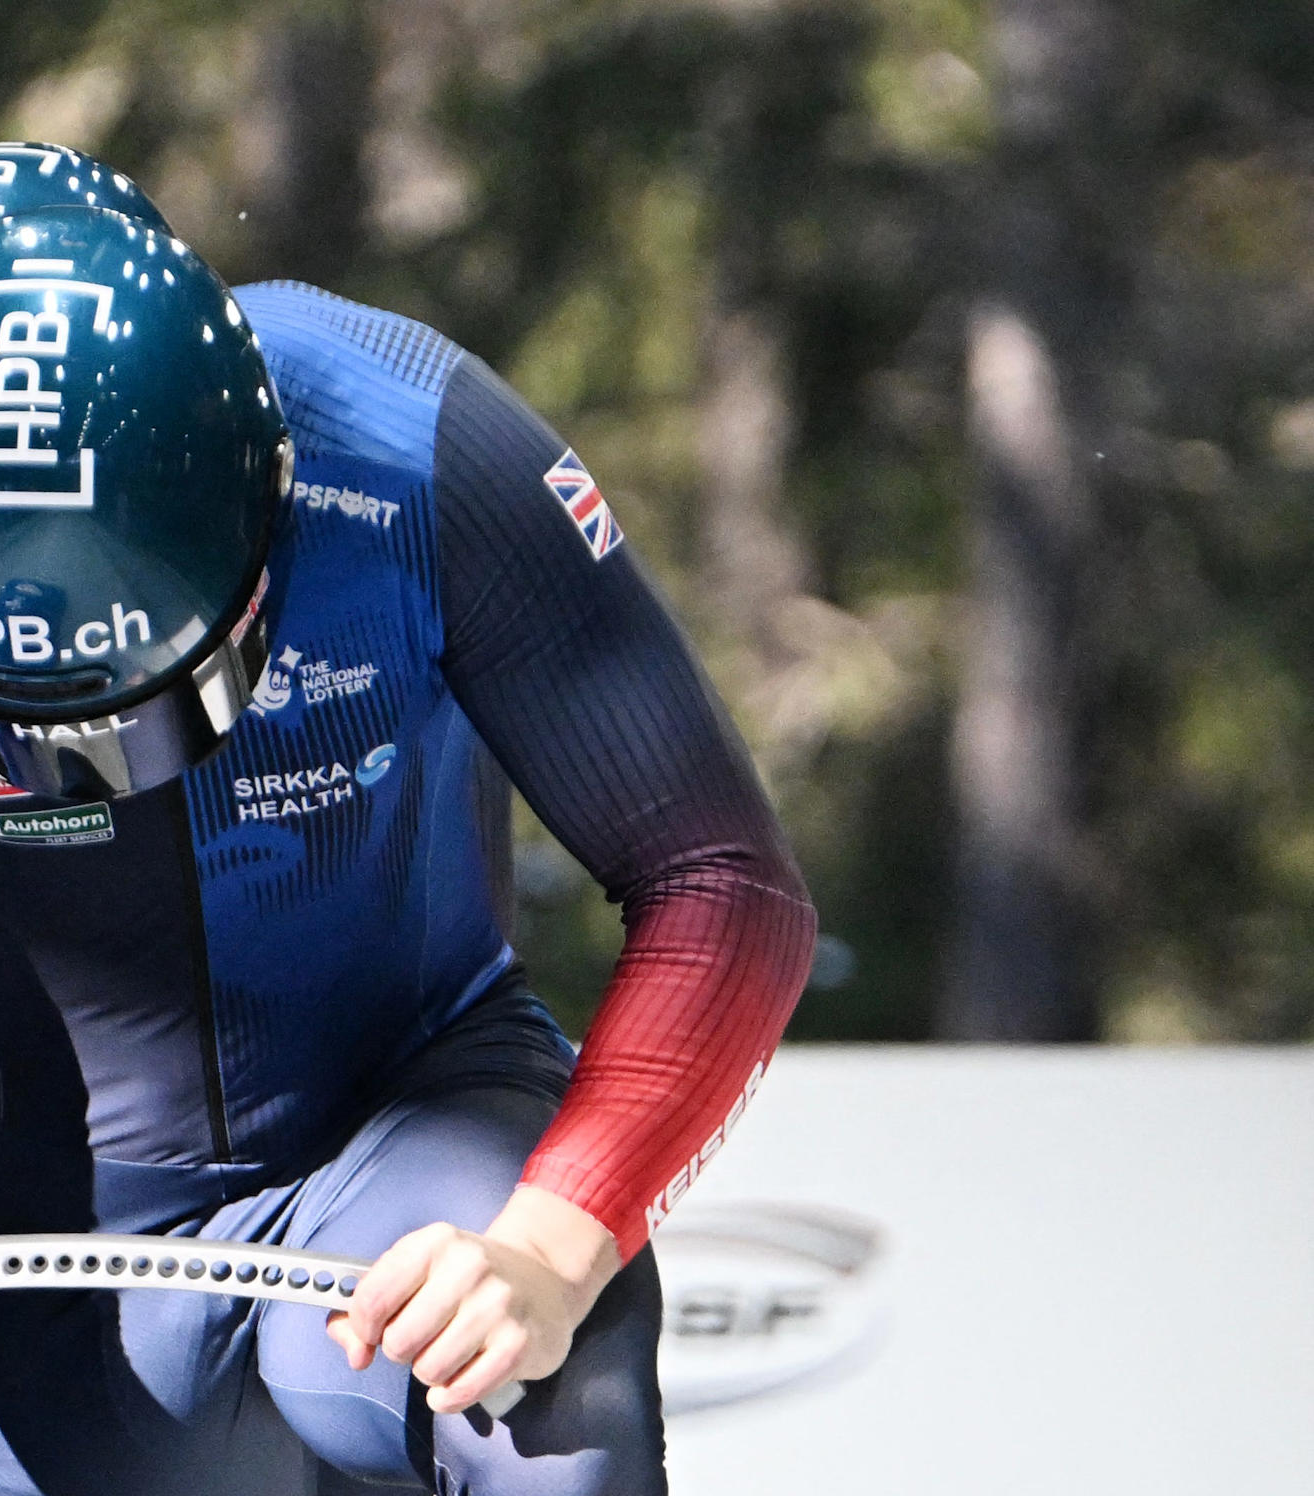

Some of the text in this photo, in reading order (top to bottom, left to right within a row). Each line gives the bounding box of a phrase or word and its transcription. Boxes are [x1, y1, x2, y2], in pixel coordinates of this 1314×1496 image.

[299, 659, 332, 678] THE
[301, 662, 380, 691] NATIONAL
[11, 714, 139, 739] HALL
[235, 762, 350, 798] SIRKKA
[238, 783, 353, 821] HEALTH
[3, 813, 107, 832] Autohorn
[644, 1059, 766, 1240] KEISER
